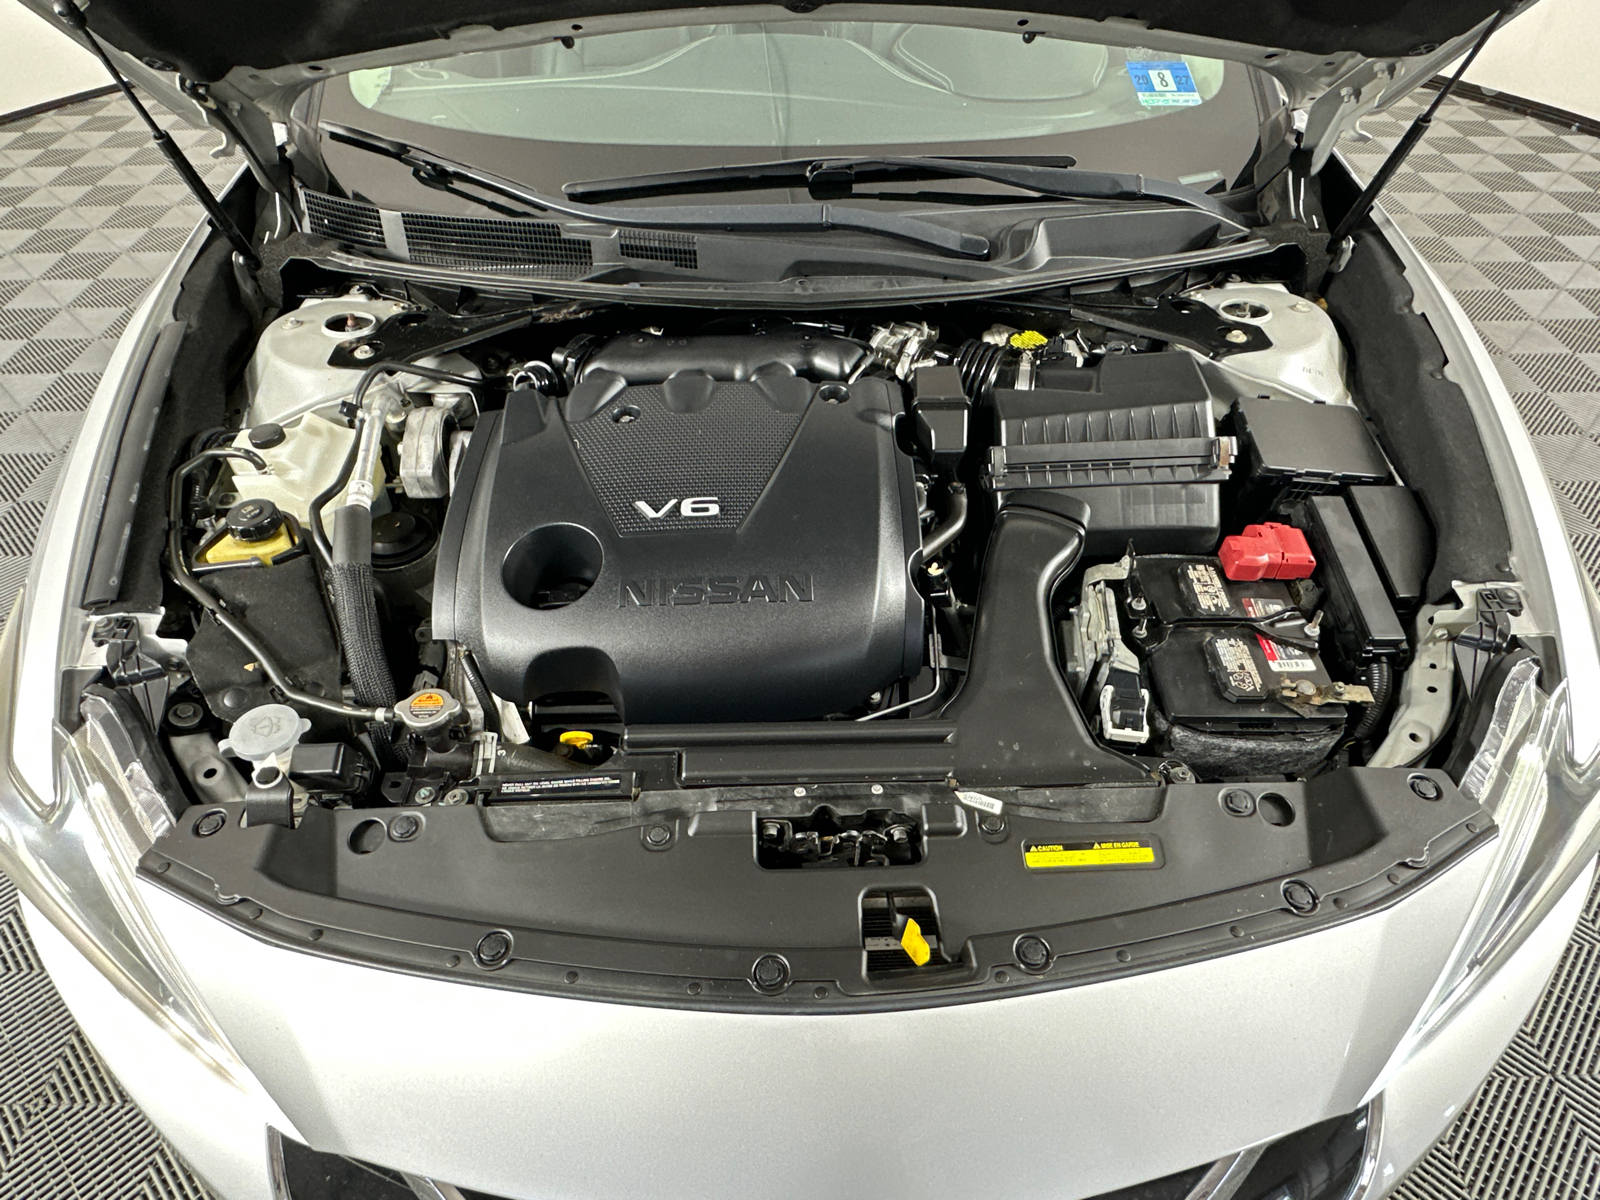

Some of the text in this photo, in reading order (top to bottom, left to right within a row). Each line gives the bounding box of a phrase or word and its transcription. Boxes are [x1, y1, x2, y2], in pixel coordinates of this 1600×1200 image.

[1134, 71, 1189, 88] 20 8 27
[633, 496, 720, 520] V6
[618, 574, 815, 608] NISSAN
